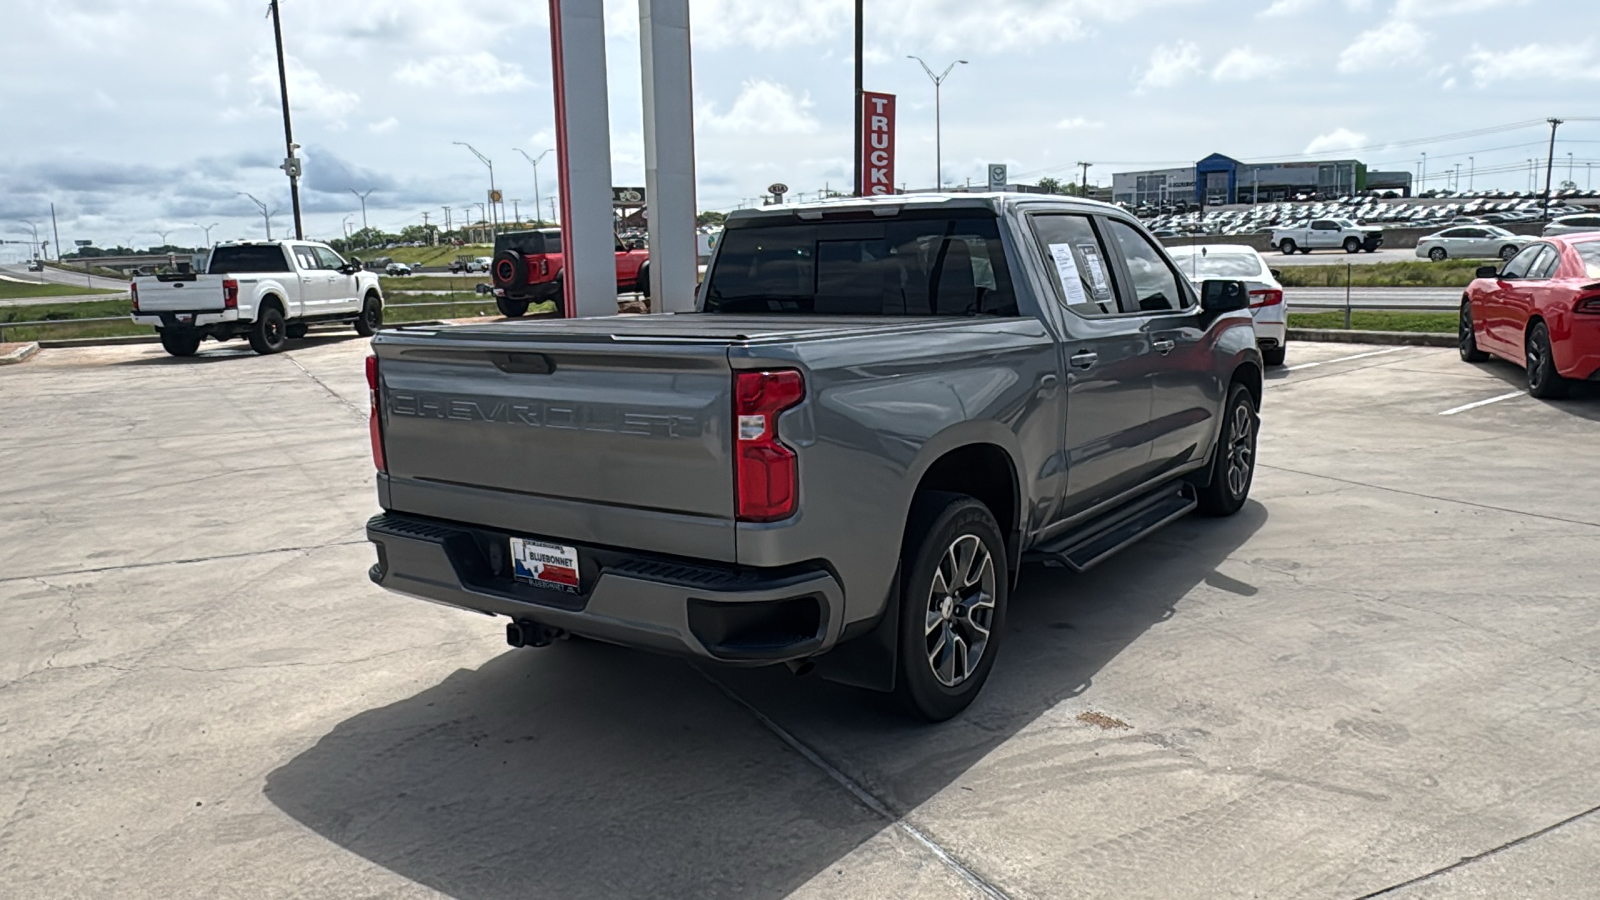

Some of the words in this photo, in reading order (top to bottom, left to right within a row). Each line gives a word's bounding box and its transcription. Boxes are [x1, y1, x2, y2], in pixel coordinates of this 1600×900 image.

[870, 97, 889, 195] TRUCKS
[390, 395, 696, 437] CHEVROLET
[529, 551, 573, 567] BLUEBONNET
